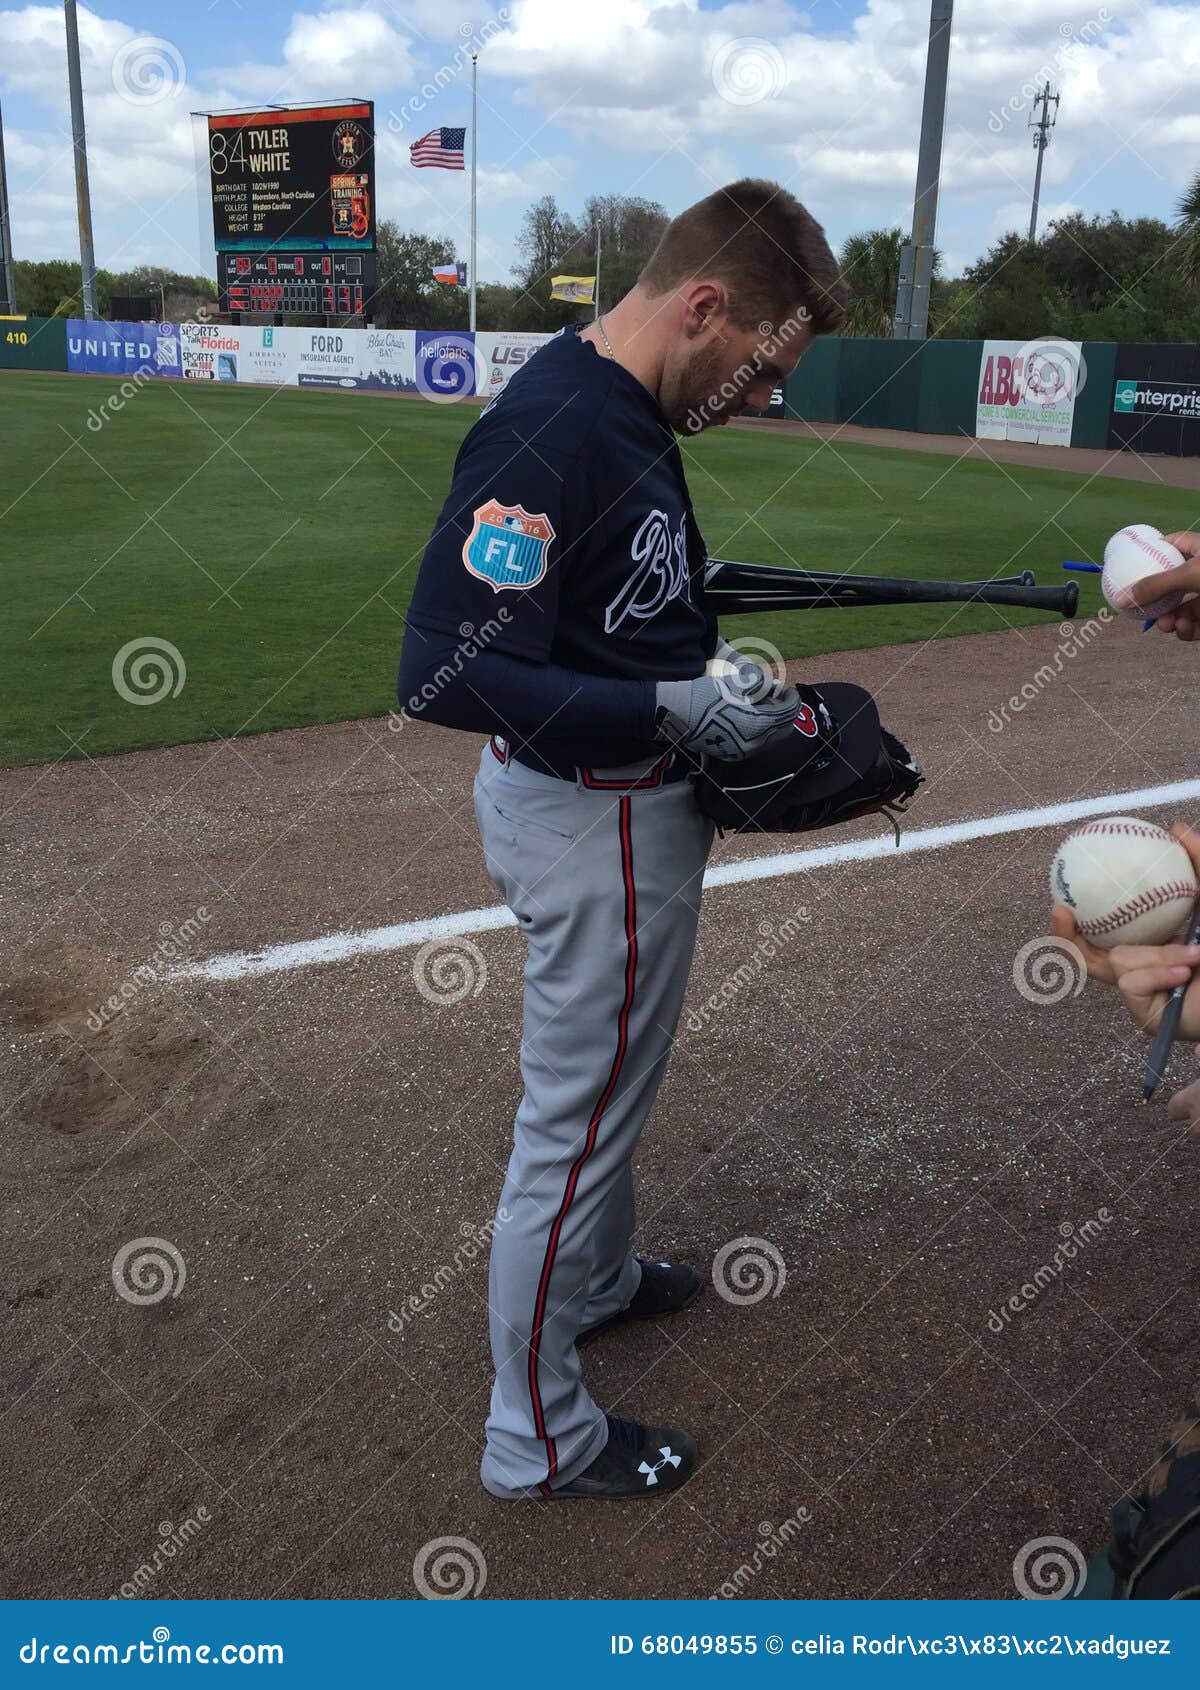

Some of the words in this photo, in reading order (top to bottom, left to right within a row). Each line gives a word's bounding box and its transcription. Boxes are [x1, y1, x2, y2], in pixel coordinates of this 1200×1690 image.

[211, 132, 248, 174] 84
[248, 129, 289, 150] TYLER
[249, 152, 291, 173] WHITE
[216, 184, 233, 193] BIRTH
[233, 183, 247, 192] DATE
[333, 189, 363, 198] TRAINING
[213, 194, 230, 203] BIRTH
[230, 193, 248, 202] PLACE
[281, 191, 294, 200] North
[295, 191, 315, 199] Carolina
[224, 203, 249, 212] COLLEGE
[271, 202, 291, 210] Carolina
[228, 213, 249, 222] HEIGHT
[227, 223, 249, 232] WEIGHT
[181, 325, 219, 337] SPORTS
[6, 331, 28, 345] 410
[187, 336, 201, 344] Talk
[201, 337, 240, 351] Florida
[311, 335, 343, 353] FORD
[69, 338, 151, 359] UNITED
[182, 351, 215, 362] SPORTS
[300, 352, 331, 363] INSURANCE
[333, 354, 354, 365] AGENCY
[979, 355, 1024, 407] ABC
[528, 525, 540, 535] 16
[484, 537, 524, 573] FL
